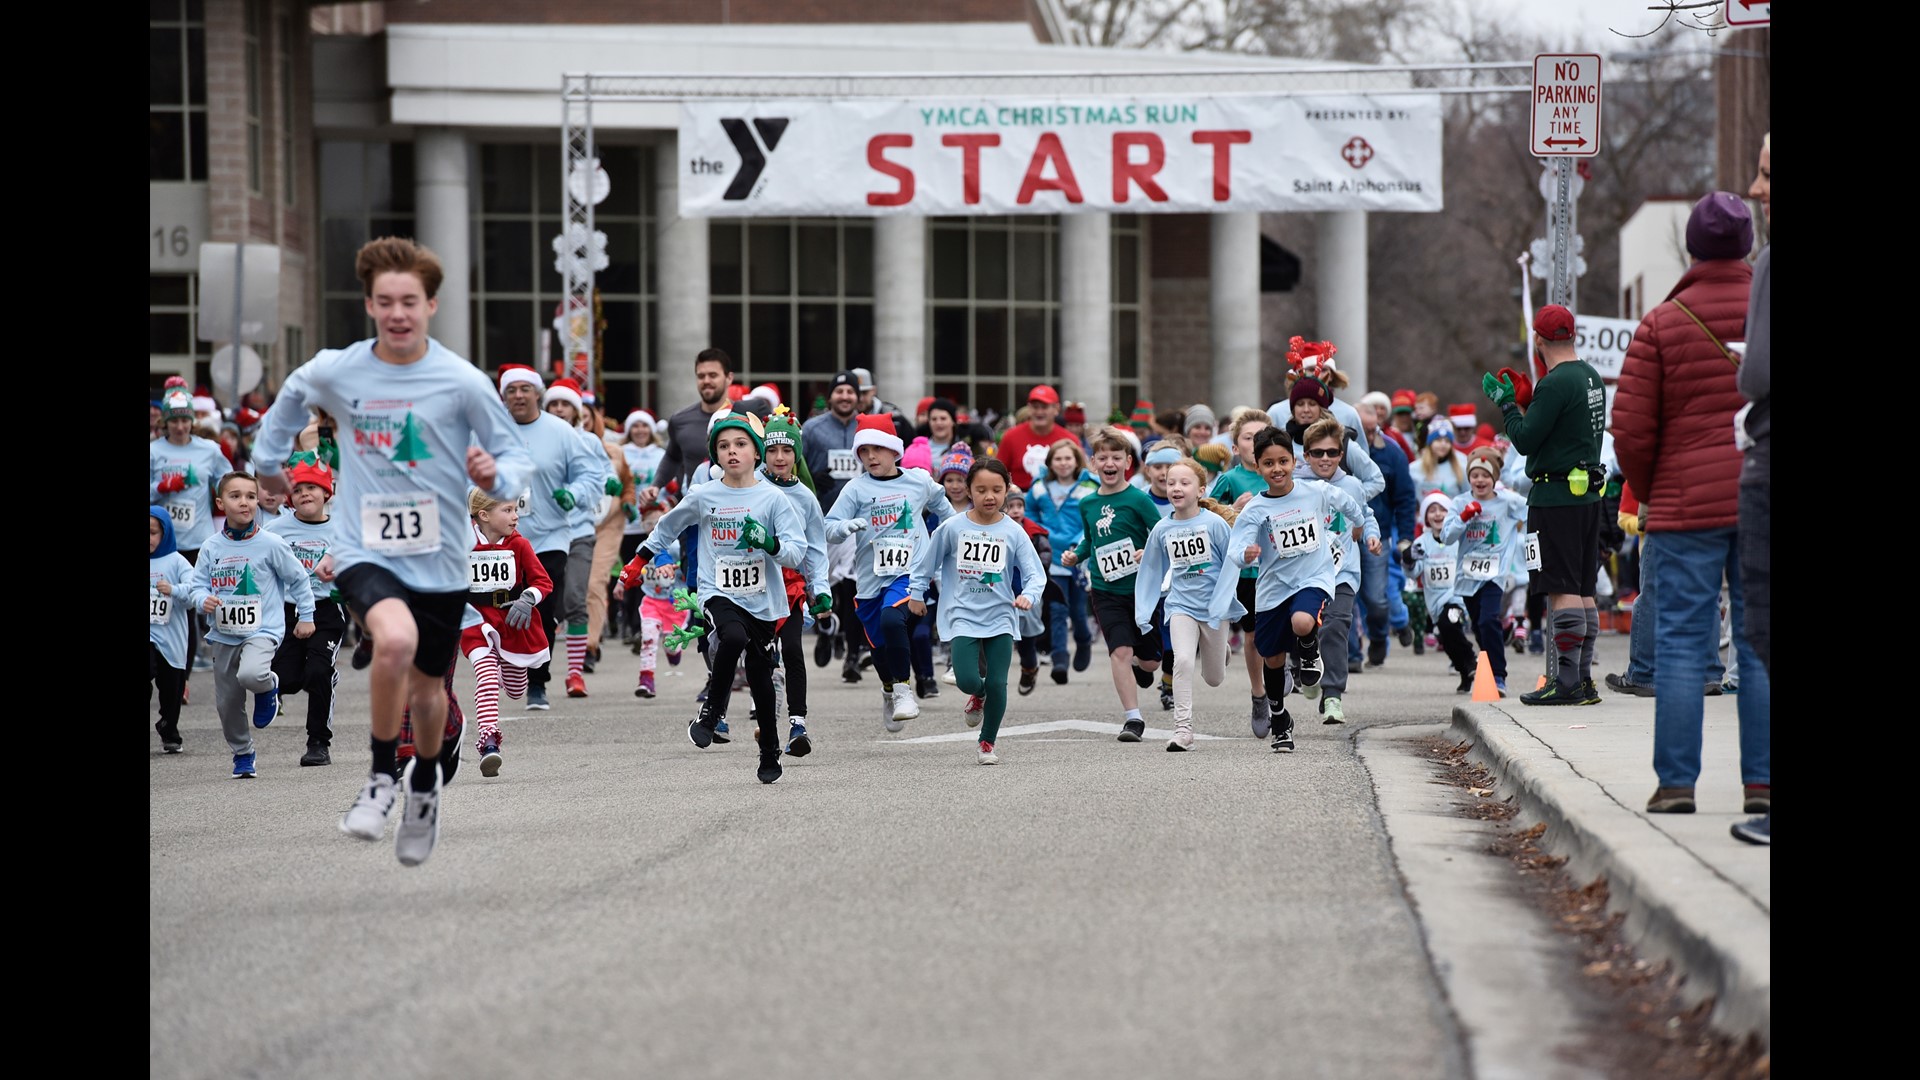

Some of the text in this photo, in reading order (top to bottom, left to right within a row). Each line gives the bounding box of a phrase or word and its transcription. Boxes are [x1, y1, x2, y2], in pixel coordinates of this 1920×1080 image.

[1554, 62, 1580, 82] NO
[1537, 84, 1596, 104] PARKING
[920, 104, 1198, 127] YMCA CHRISTMAS RUN
[1305, 110, 1383, 121] PRESENTED
[1552, 106, 1580, 119] ANY
[1550, 121, 1581, 135] TIME
[690, 156, 724, 175] the
[866, 130, 1253, 207] START
[1293, 178, 1423, 195] Saint Alphonsus
[763, 437, 796, 447] VERYTHING
[766, 431, 788, 440] MERRY
[379, 510, 423, 540] 213
[871, 513, 898, 527] RUN
[711, 528, 737, 541] RUN
[1280, 523, 1316, 549] 2134
[963, 541, 1000, 564] 2170
[1172, 537, 1206, 559] 2169
[879, 548, 909, 568] 1443
[1101, 550, 1134, 574] 2142
[471, 562, 510, 583] 1948
[722, 566, 760, 589] 1813
[1430, 566, 1450, 581] 853
[211, 577, 237, 588] RUN
[221, 606, 256, 625] 1405
